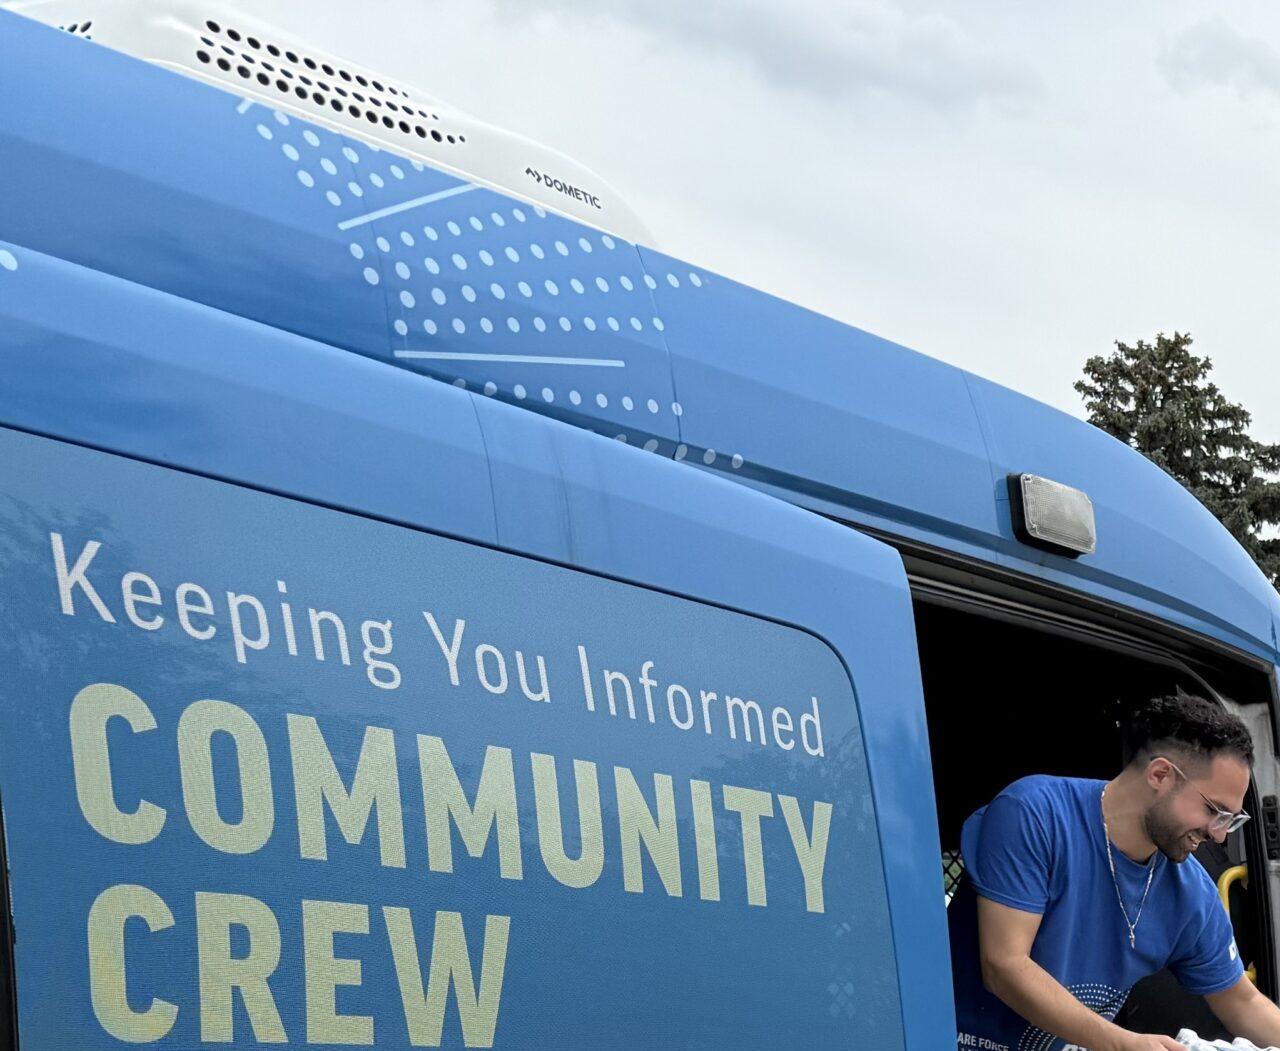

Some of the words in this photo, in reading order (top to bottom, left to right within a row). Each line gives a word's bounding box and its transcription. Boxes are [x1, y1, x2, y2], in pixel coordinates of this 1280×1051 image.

[543, 174, 602, 210] DOMETIC
[48, 532, 402, 690] Keeping
[423, 611, 552, 704] You
[577, 644, 825, 757] Informed
[68, 682, 834, 914] COMMUNITY
[86, 883, 512, 1049] CREW
[957, 1032, 977, 1047] ARE
